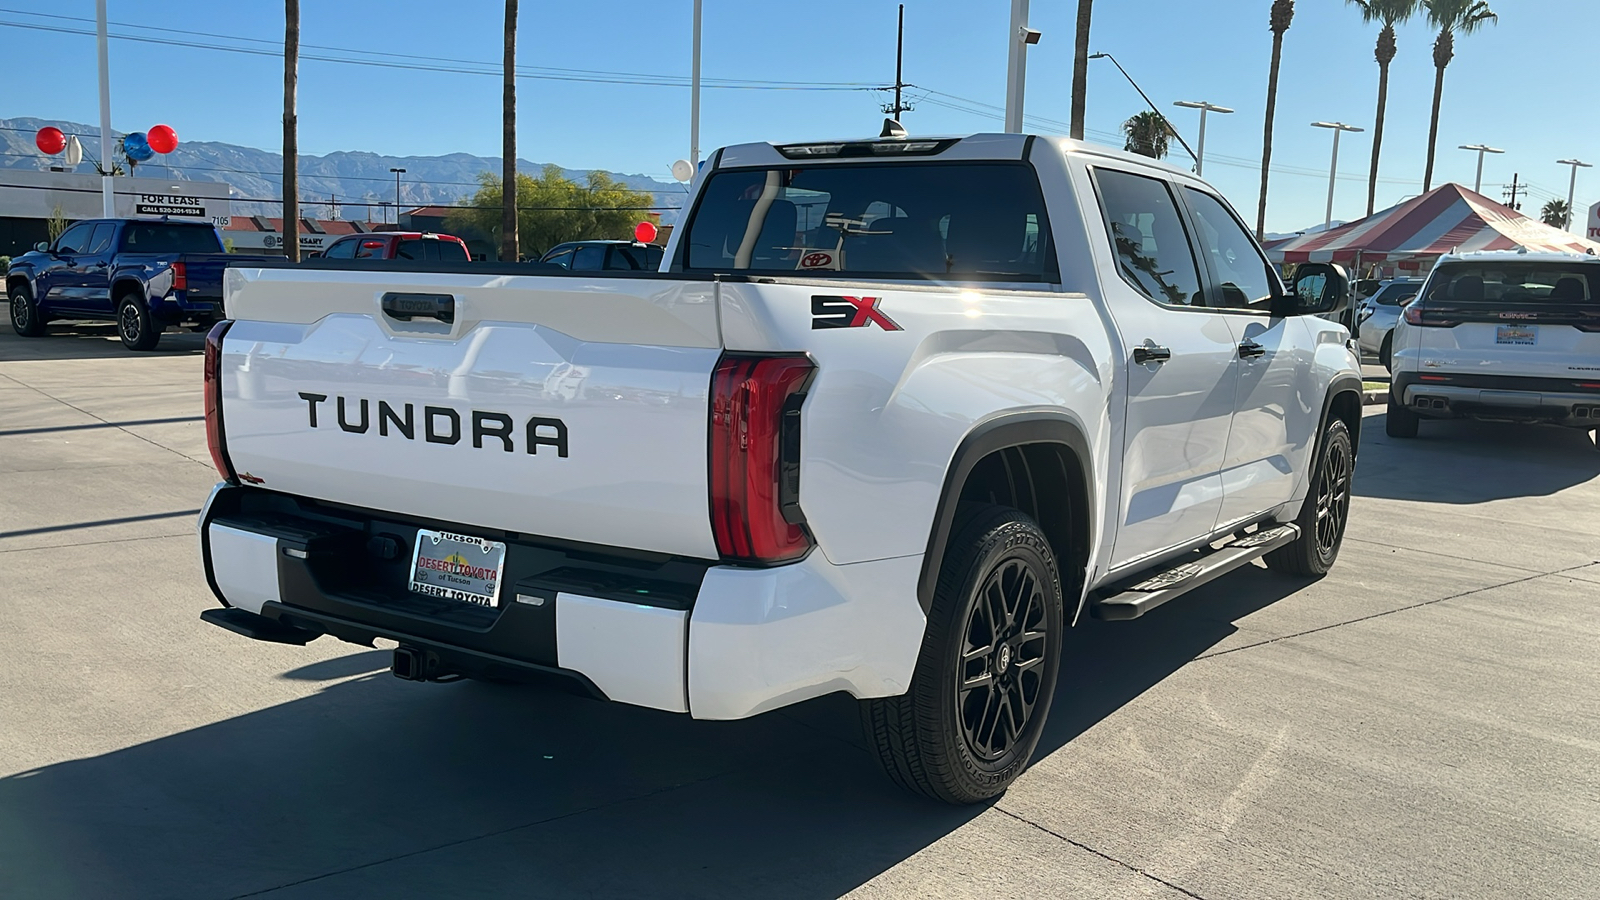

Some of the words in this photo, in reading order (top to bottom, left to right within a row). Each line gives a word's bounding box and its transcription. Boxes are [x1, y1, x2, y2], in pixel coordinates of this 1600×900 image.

[142, 194, 164, 203] FOR
[168, 195, 200, 206] LEASE
[212, 216, 229, 225] 7105
[399, 300, 434, 311] TOYOTA
[298, 392, 569, 458] TUNDRA
[440, 532, 482, 545] TUCSON
[419, 557, 456, 573] DESERT
[458, 563, 497, 581] TOYOTA
[438, 573, 447, 581] of
[447, 574, 471, 586] Tucson
[412, 583, 448, 598] DESERT
[451, 590, 492, 607] TOYOTA
